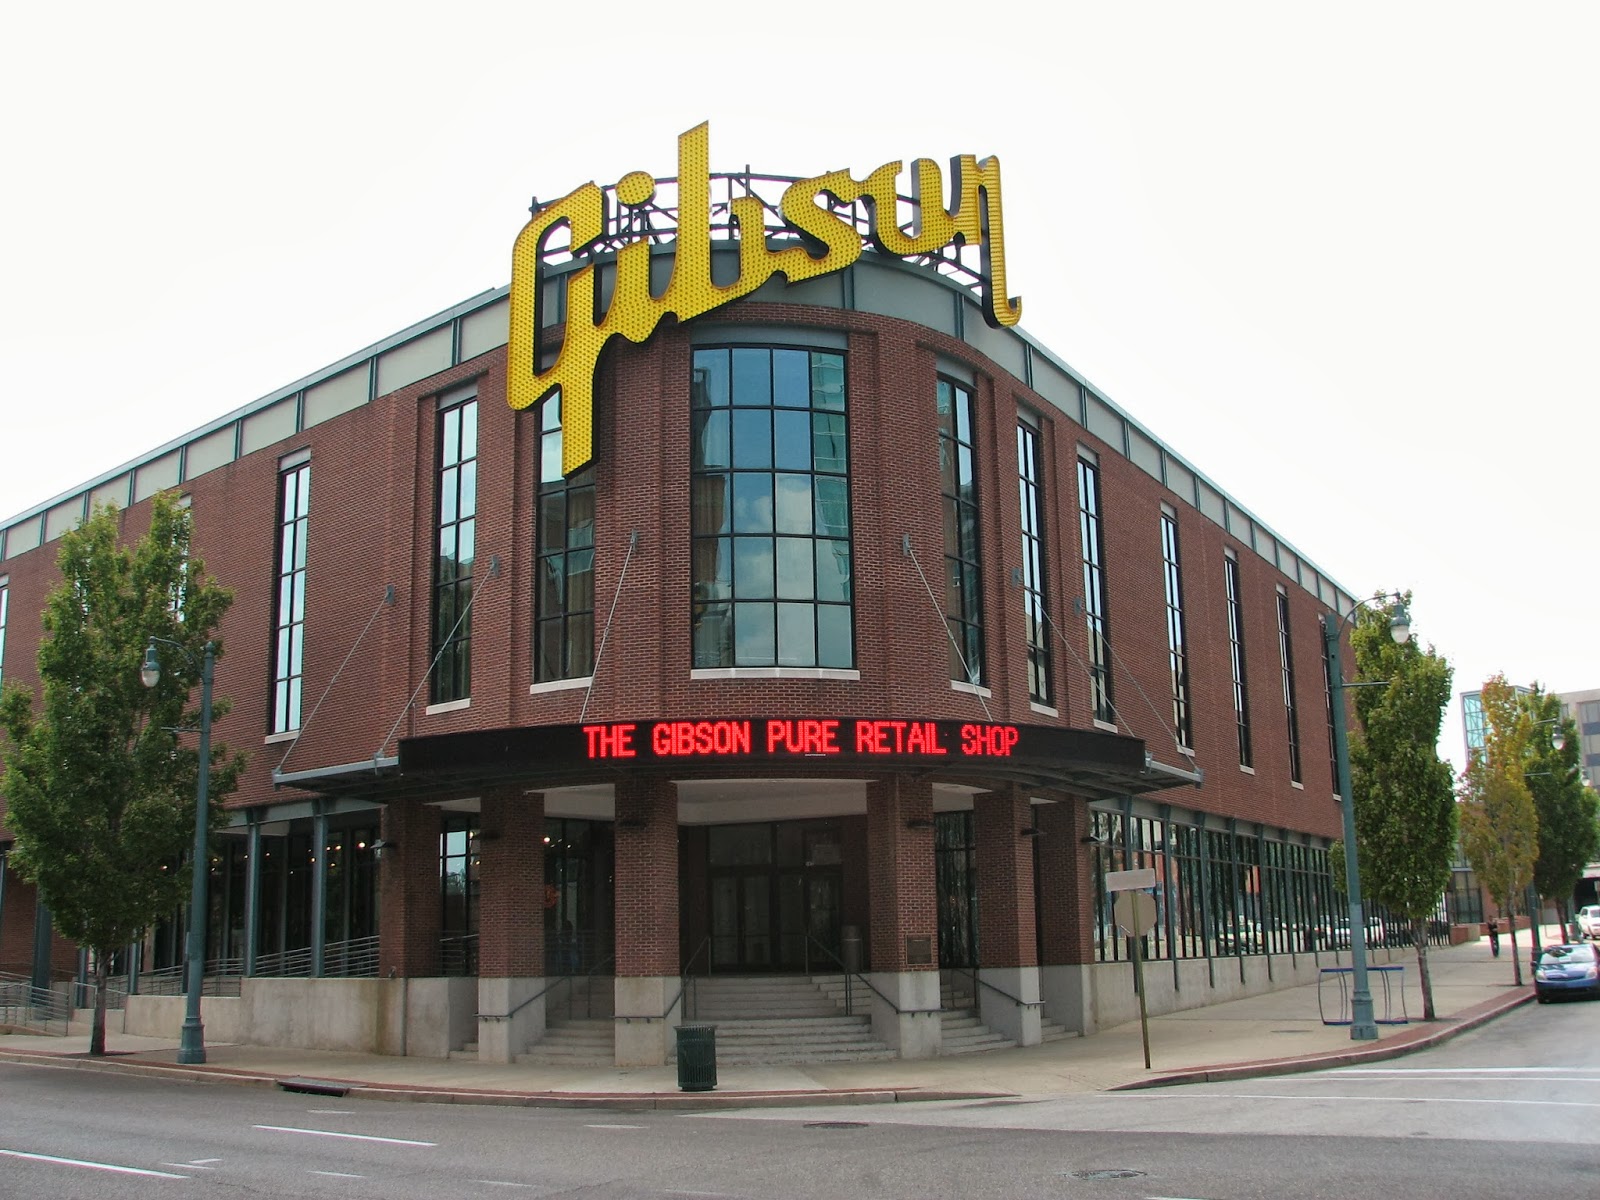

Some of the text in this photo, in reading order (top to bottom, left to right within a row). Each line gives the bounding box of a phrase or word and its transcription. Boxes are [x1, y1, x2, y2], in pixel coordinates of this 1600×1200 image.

[507, 120, 1022, 477] Gibson
[583, 720, 1019, 758] THE GIBSON PURE RETAIL SHOP
